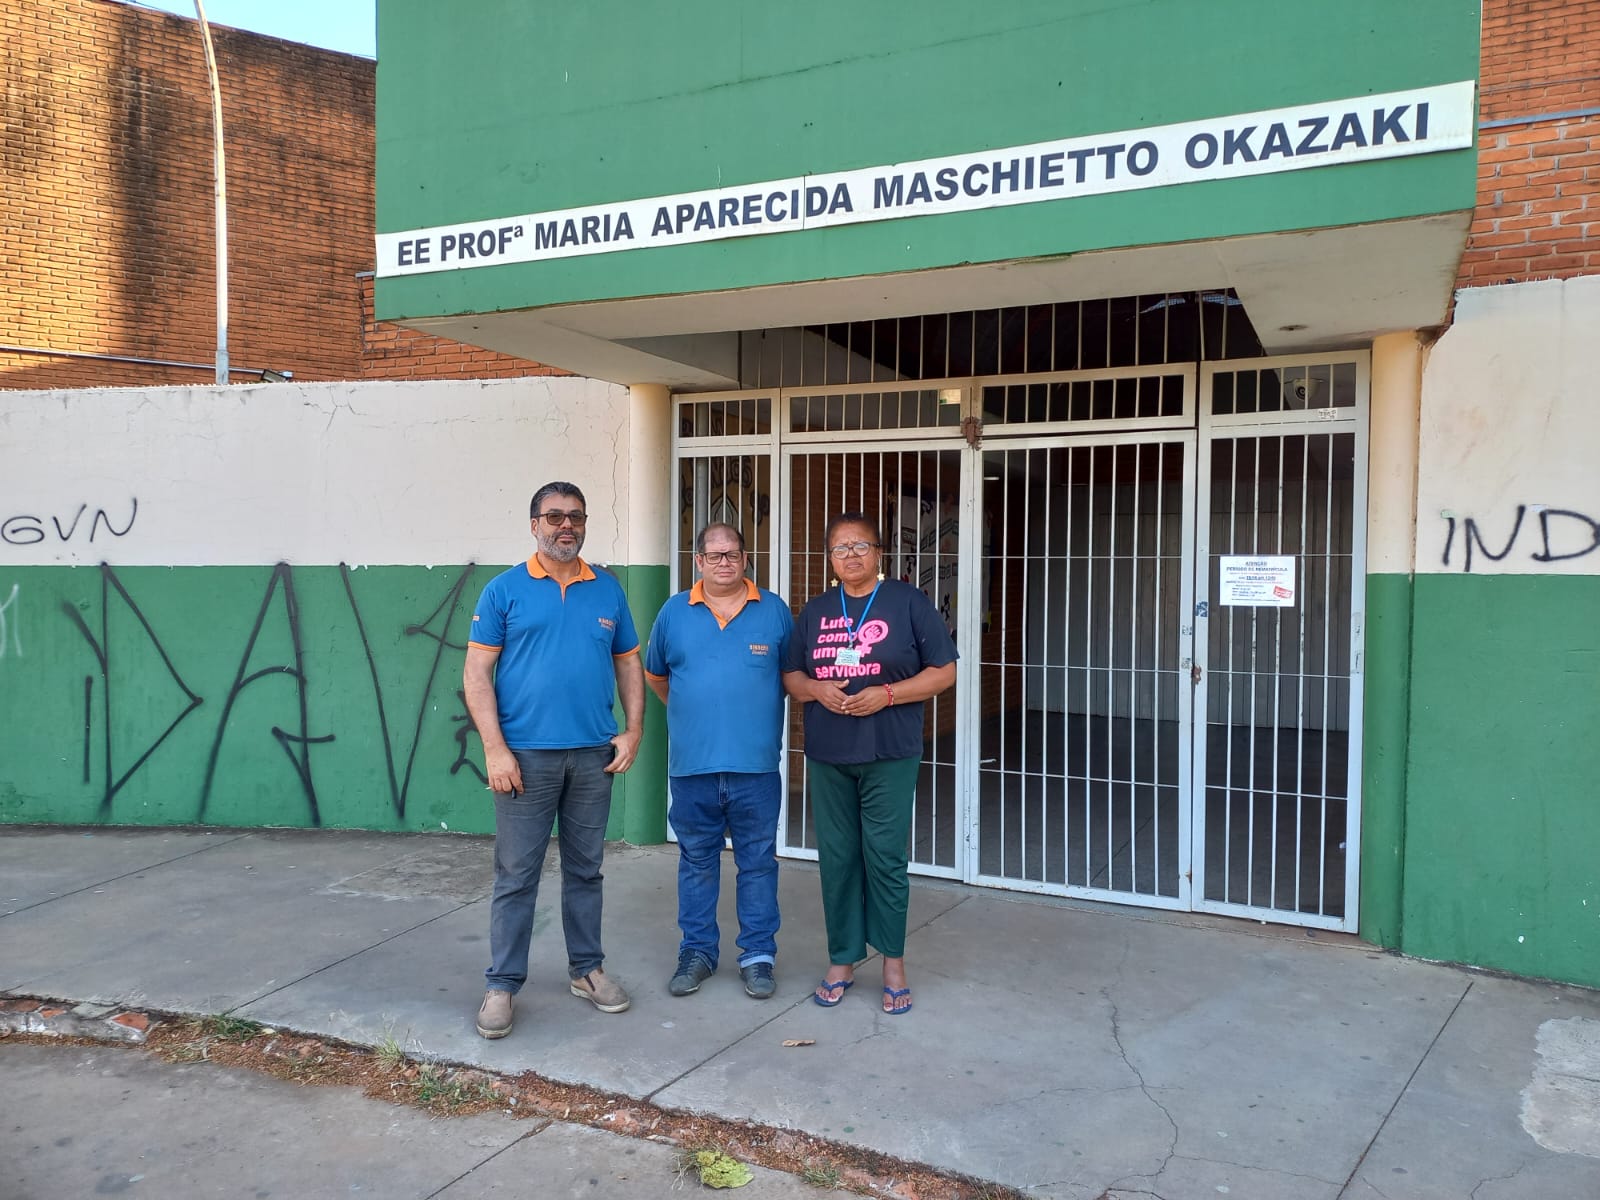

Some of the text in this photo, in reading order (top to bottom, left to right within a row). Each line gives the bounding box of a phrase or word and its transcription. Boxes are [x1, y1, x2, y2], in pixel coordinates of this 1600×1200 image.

[398, 239, 430, 266] EE
[535, 212, 635, 250] MARIA
[651, 183, 854, 237] APARECIDA
[873, 141, 1159, 209] MASCHIETTO
[1185, 102, 1429, 169] OKAZAKI
[820, 616, 854, 630] Lute
[817, 632, 858, 644] como
[815, 662, 881, 678] servidora
